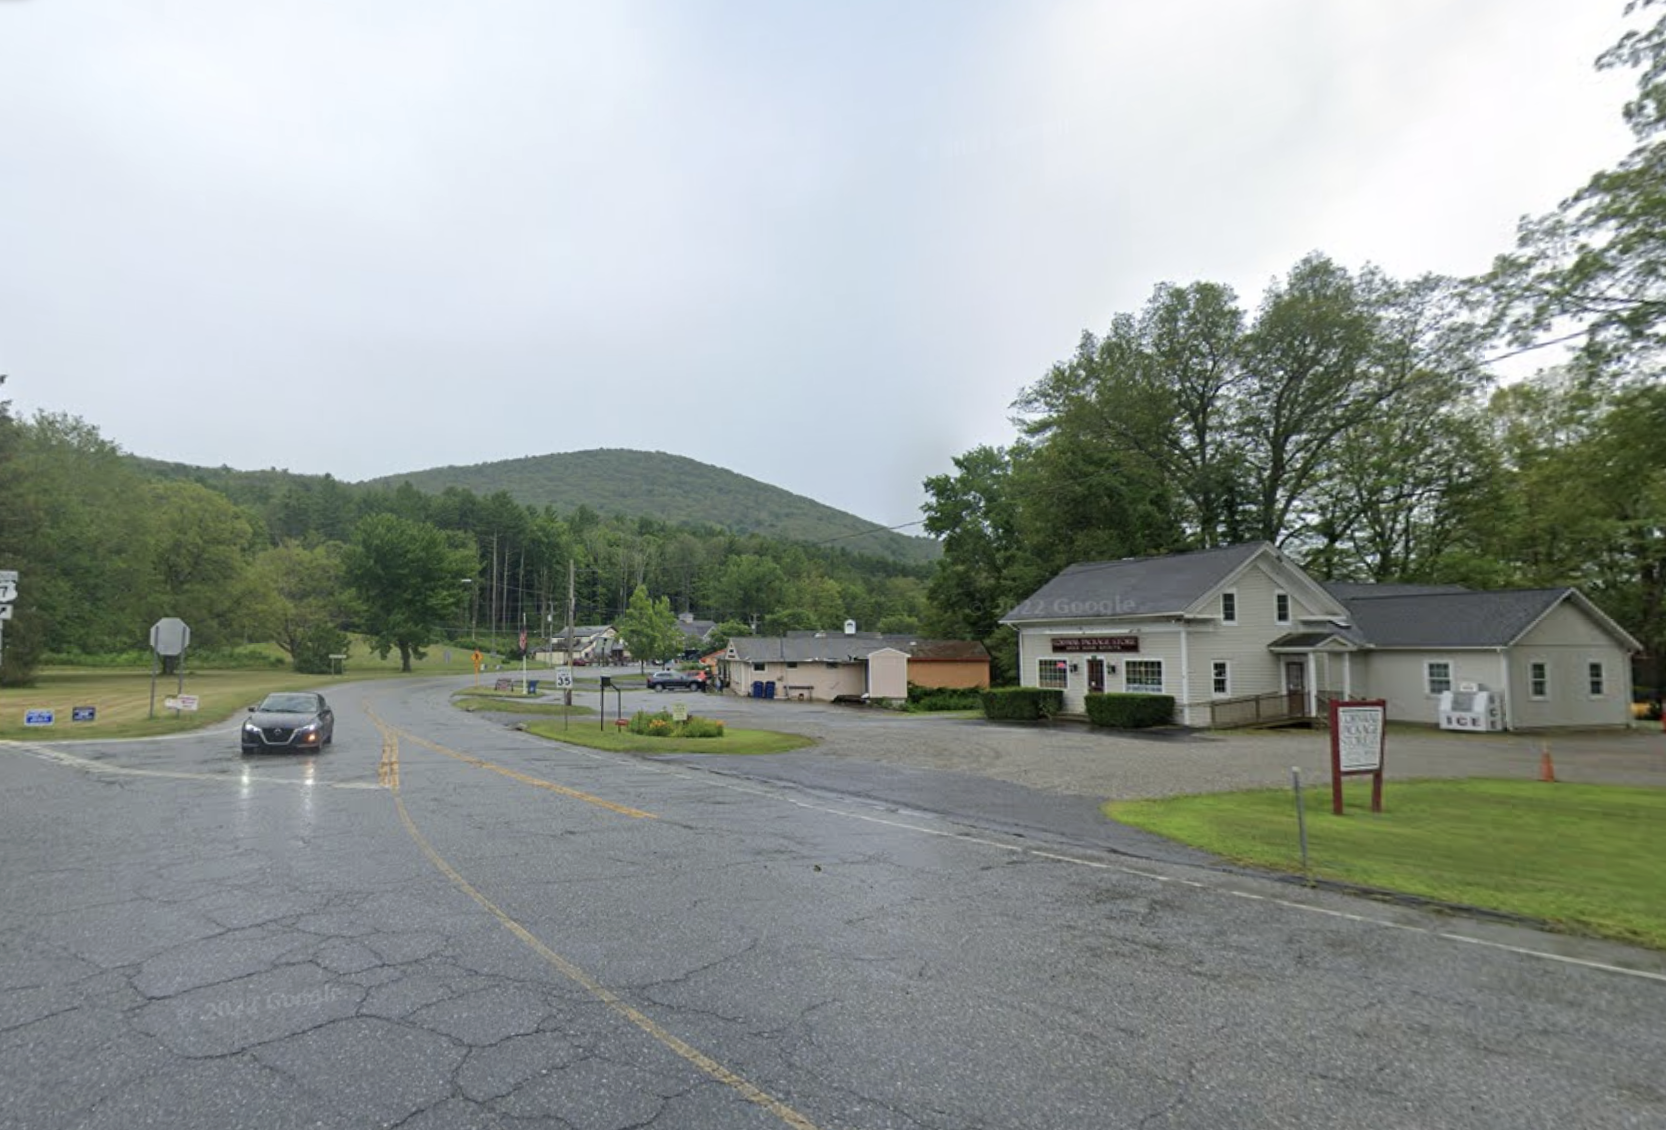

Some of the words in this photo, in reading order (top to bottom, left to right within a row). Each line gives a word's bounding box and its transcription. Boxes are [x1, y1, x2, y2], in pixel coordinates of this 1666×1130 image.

[0, 586, 8, 598] 7
[558, 676, 571, 686] 35
[1446, 715, 1481, 727] ICE
